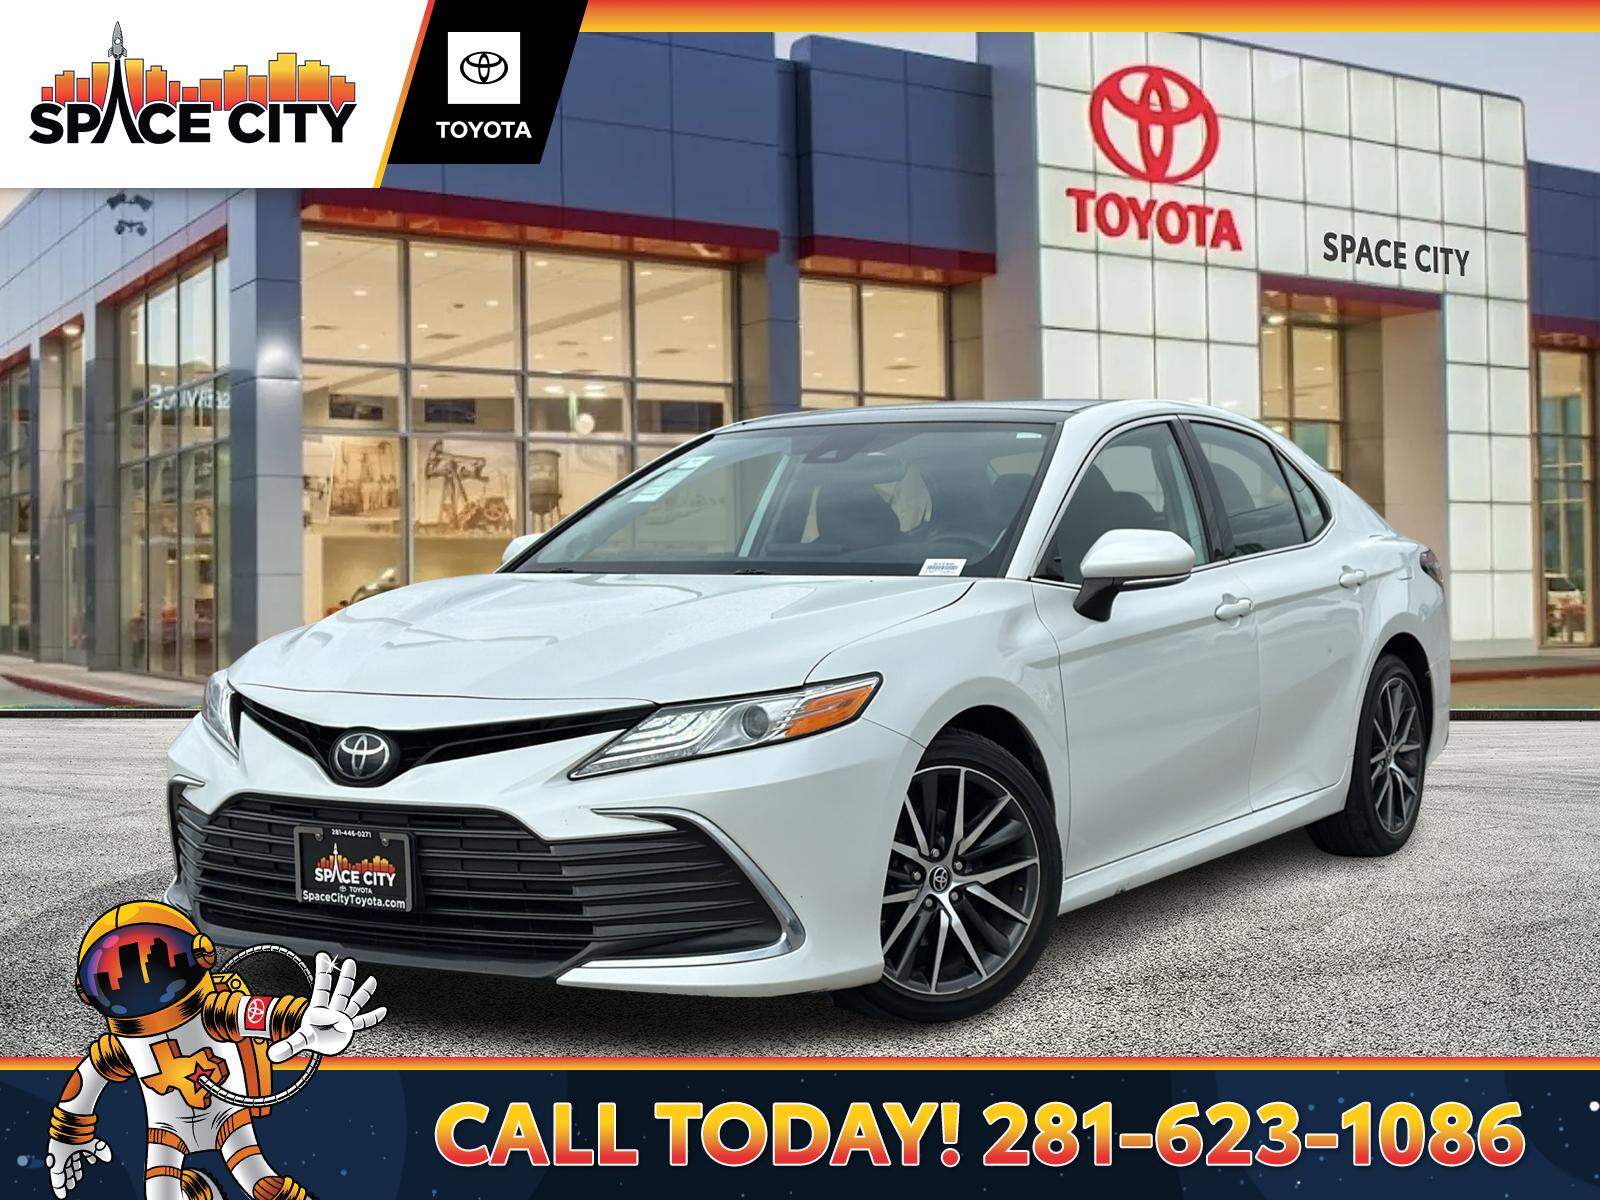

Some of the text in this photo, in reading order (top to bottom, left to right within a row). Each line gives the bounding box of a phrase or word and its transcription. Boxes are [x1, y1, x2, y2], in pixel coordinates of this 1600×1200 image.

[1065, 187, 1243, 251] TOYOTA
[1323, 232, 1470, 277] SPACE CITY
[331, 828, 372, 838] 281-446-0271
[314, 862, 396, 887] SPACE CITY
[302, 890, 406, 909] SpaceCityToyota.com
[350, 886, 373, 894] TOYOTA
